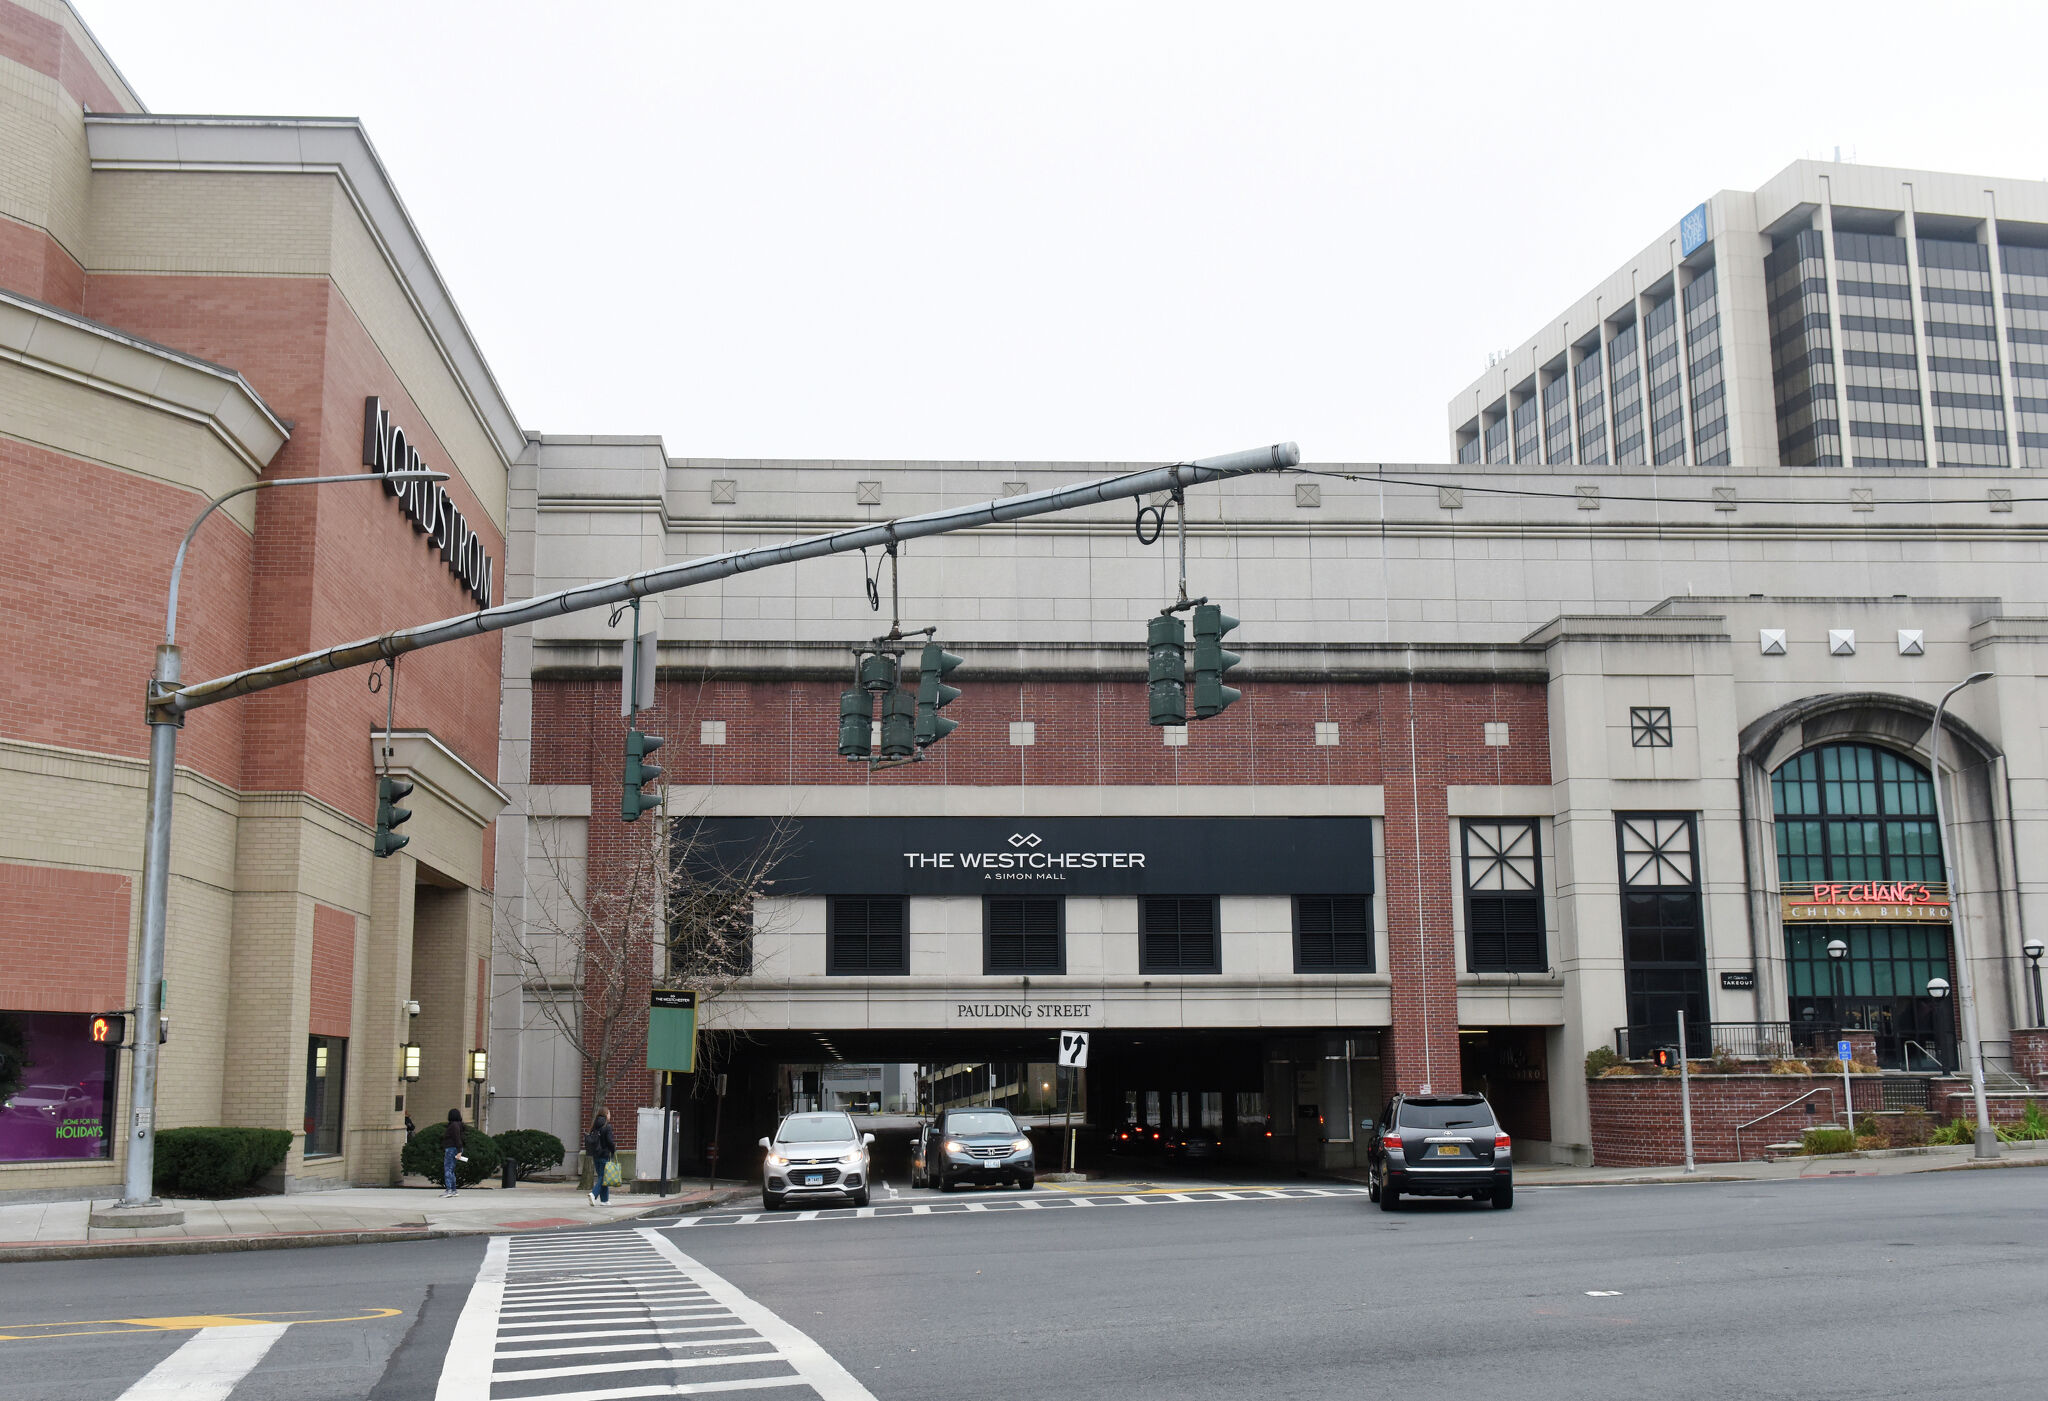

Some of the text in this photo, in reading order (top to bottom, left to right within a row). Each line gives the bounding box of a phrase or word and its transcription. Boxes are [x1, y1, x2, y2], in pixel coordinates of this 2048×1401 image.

[364, 396, 492, 612] NORDSTROM
[903, 852, 1146, 869] THE WESTCHESTER
[984, 872, 1066, 880] A SIMON MALL
[1814, 884, 1845, 905] P.F.
[1791, 907, 1948, 917] CHINA BISTRO
[957, 1004, 1091, 1017] PAULDING STREET
[56, 1125, 103, 1138] HOLIDAYS
